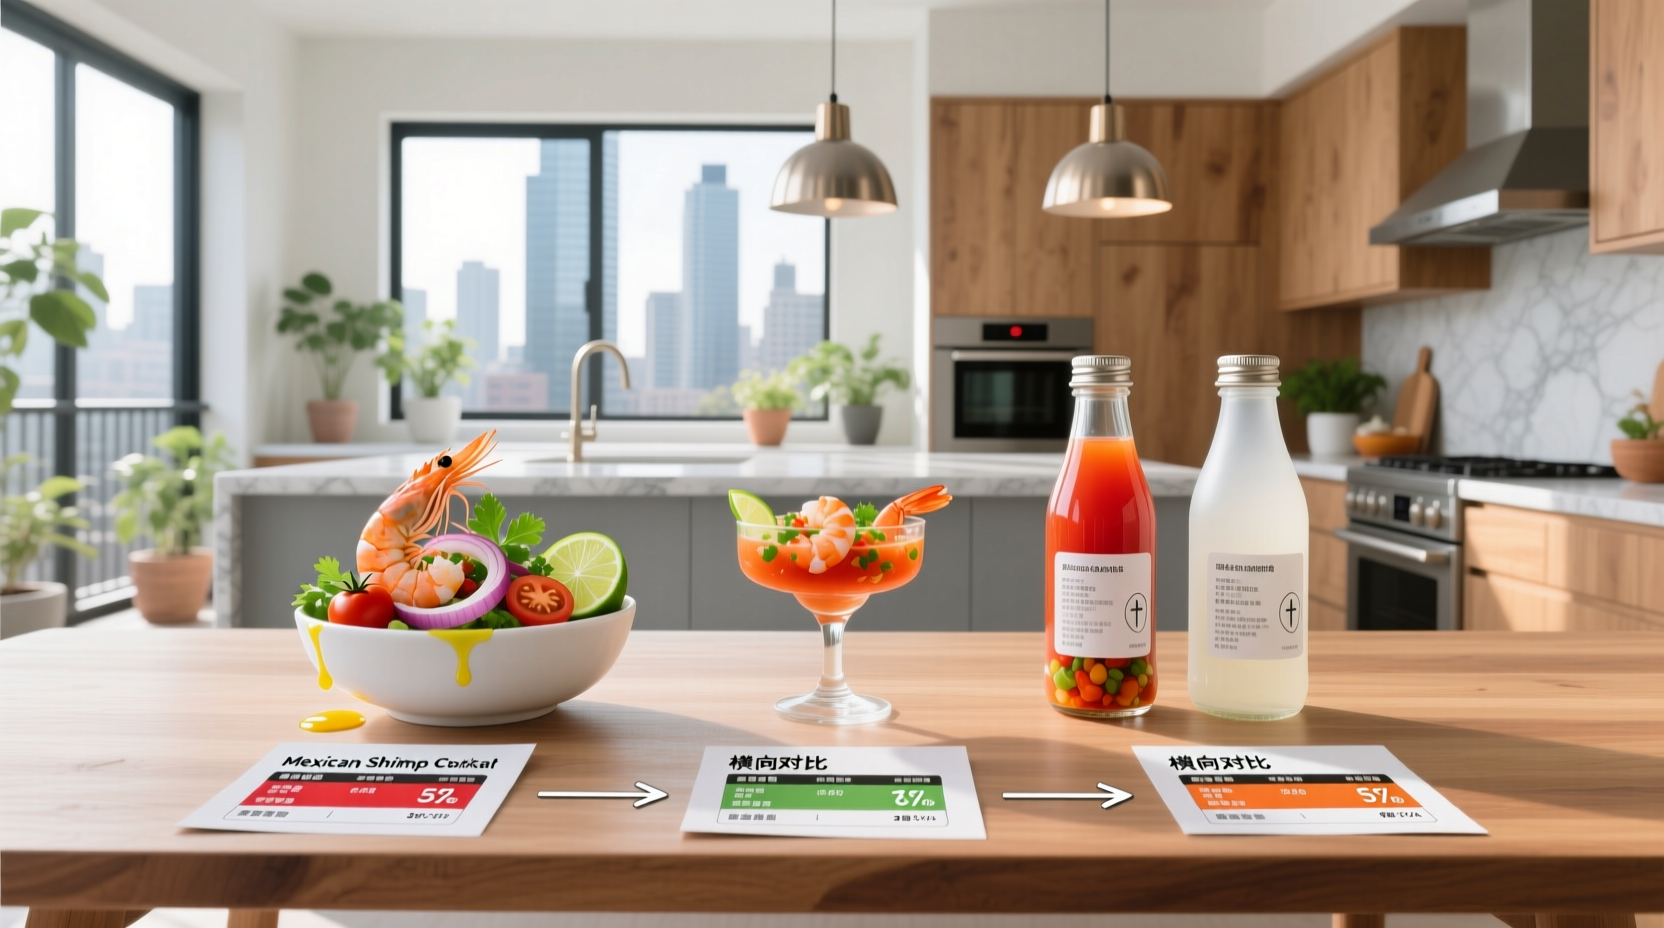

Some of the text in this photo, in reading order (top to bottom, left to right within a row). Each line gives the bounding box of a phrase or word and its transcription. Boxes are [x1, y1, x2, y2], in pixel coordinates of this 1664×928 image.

[282, 756, 361, 769] Mexican
[728, 754, 828, 771] 横向对比
[1168, 754, 1272, 771] 横向对比
